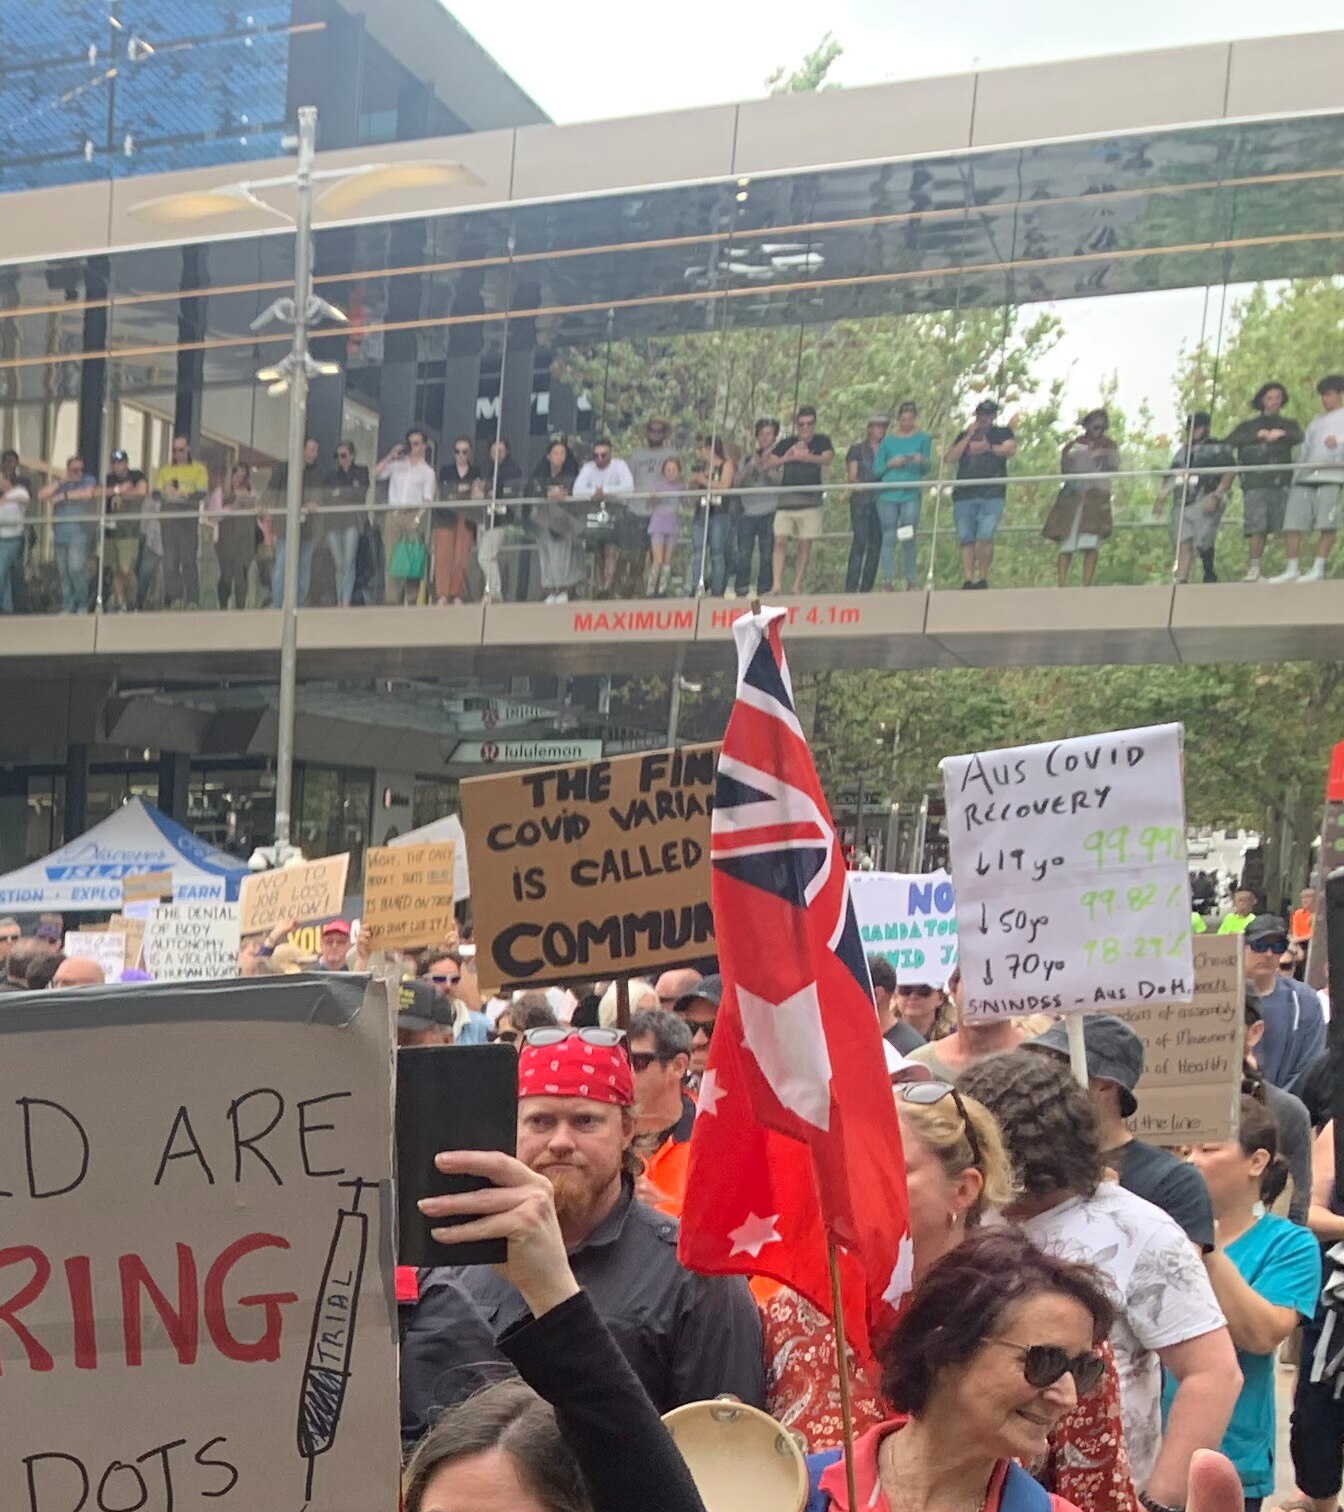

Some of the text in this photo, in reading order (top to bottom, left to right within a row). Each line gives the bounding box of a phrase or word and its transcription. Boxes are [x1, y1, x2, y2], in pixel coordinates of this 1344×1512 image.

[574, 606, 860, 631] MAXIMUM HET 4.1m
[504, 743, 582, 758] lululemon
[523, 761, 611, 808] THE
[964, 786, 1111, 831] RECOVERY
[256, 865, 327, 891] NO TO
[513, 837, 703, 901] IS CALLED
[291, 883, 329, 900] LOSS
[908, 881, 955, 916] NO
[155, 907, 237, 920] THE DENIAL
[151, 923, 210, 936] OF BODY
[151, 937, 224, 950] AUTONOMY
[177, 951, 239, 966] VIOLATION
[1178, 1058, 1228, 1075] Health
[154, 1087, 352, 1186] ARE
[316, 1270, 353, 1363] TRIAL
